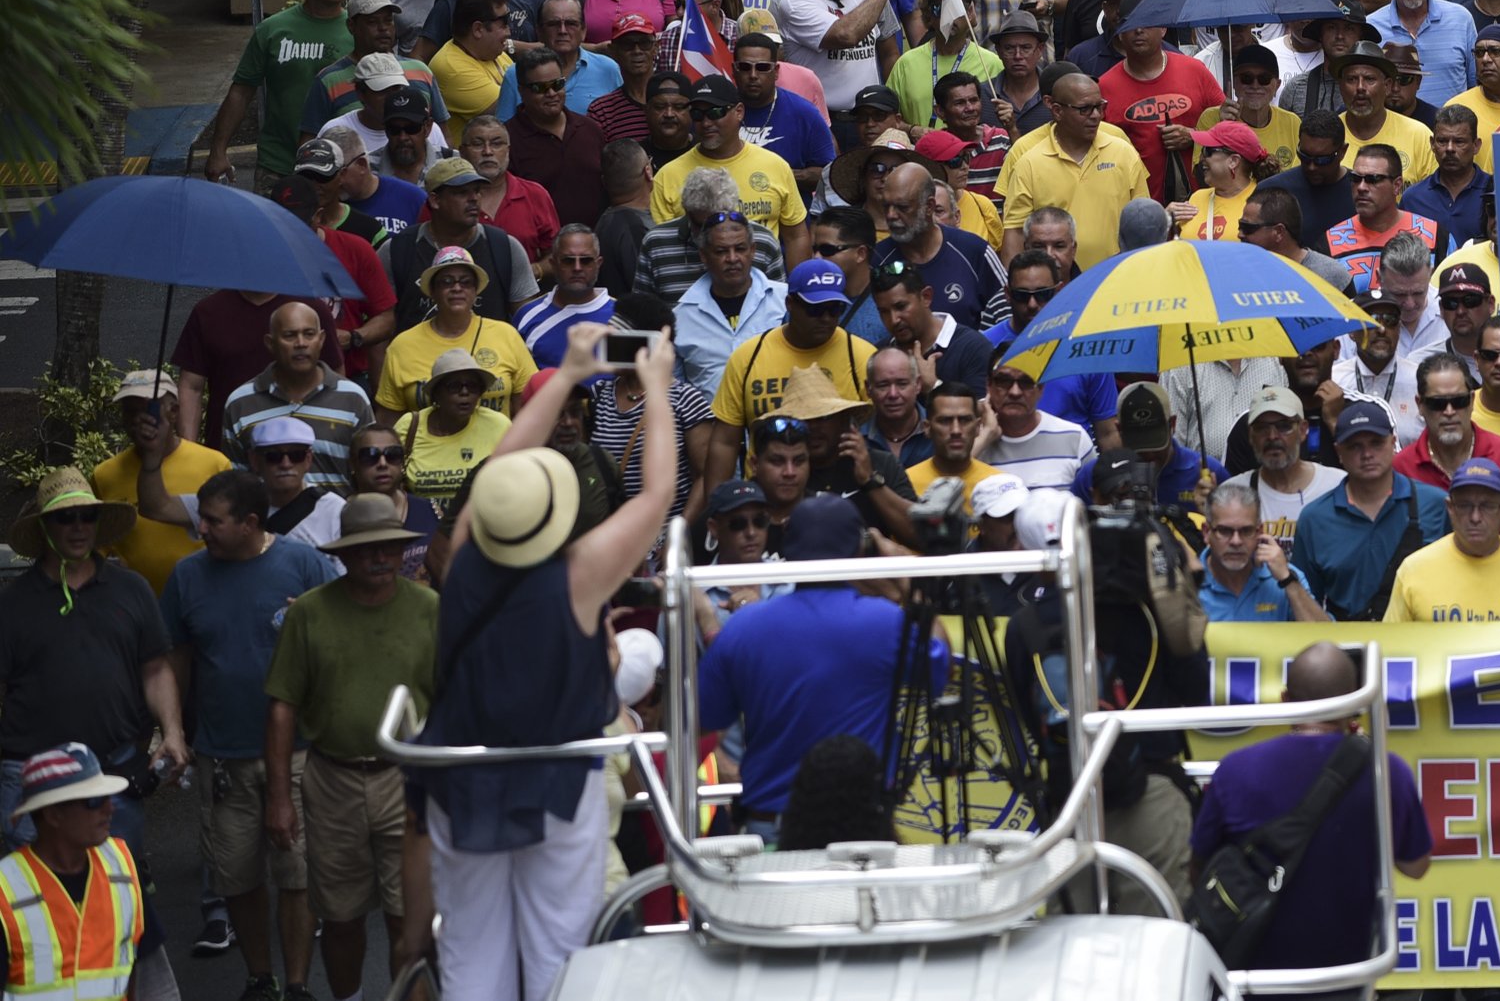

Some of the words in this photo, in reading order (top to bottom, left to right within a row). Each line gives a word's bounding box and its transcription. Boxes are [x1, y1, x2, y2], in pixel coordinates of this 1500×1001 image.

[827, 49, 839, 61] EN
[1111, 296, 1188, 317] UTIER
[1231, 290, 1306, 308] UTIER
